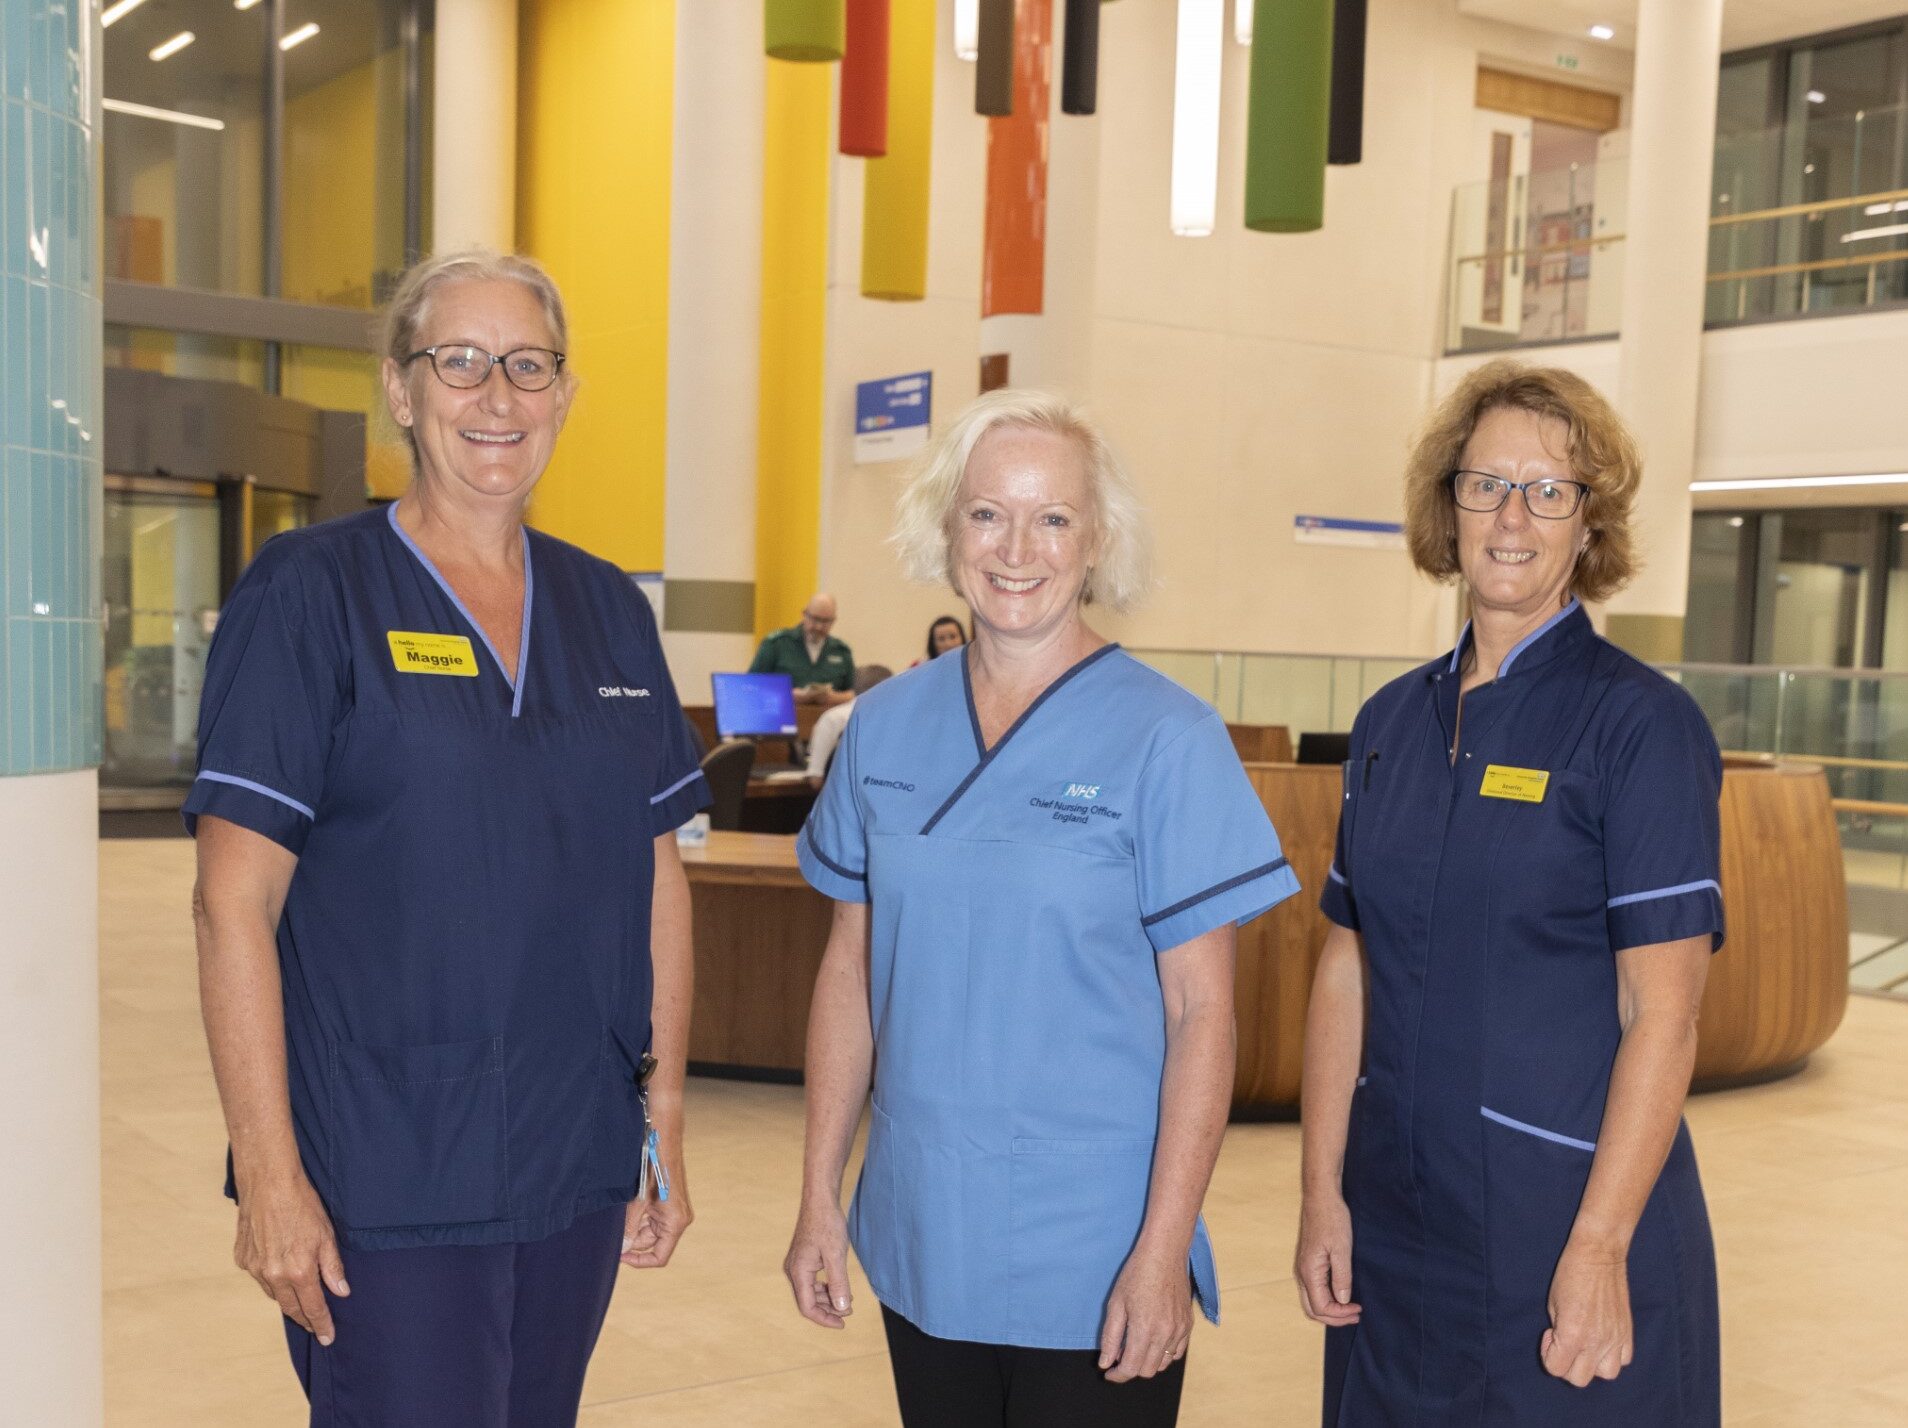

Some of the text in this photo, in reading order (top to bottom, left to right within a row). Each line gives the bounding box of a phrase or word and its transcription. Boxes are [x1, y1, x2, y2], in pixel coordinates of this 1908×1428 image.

[406, 651, 463, 666] Maggie
[622, 686, 651, 697] Nurse
[863, 775, 916, 792] #teamCNO
[1064, 783, 1101, 799] NHS
[1029, 797, 1122, 820] Chief Nursing Officer
[1052, 811, 1089, 824] England
